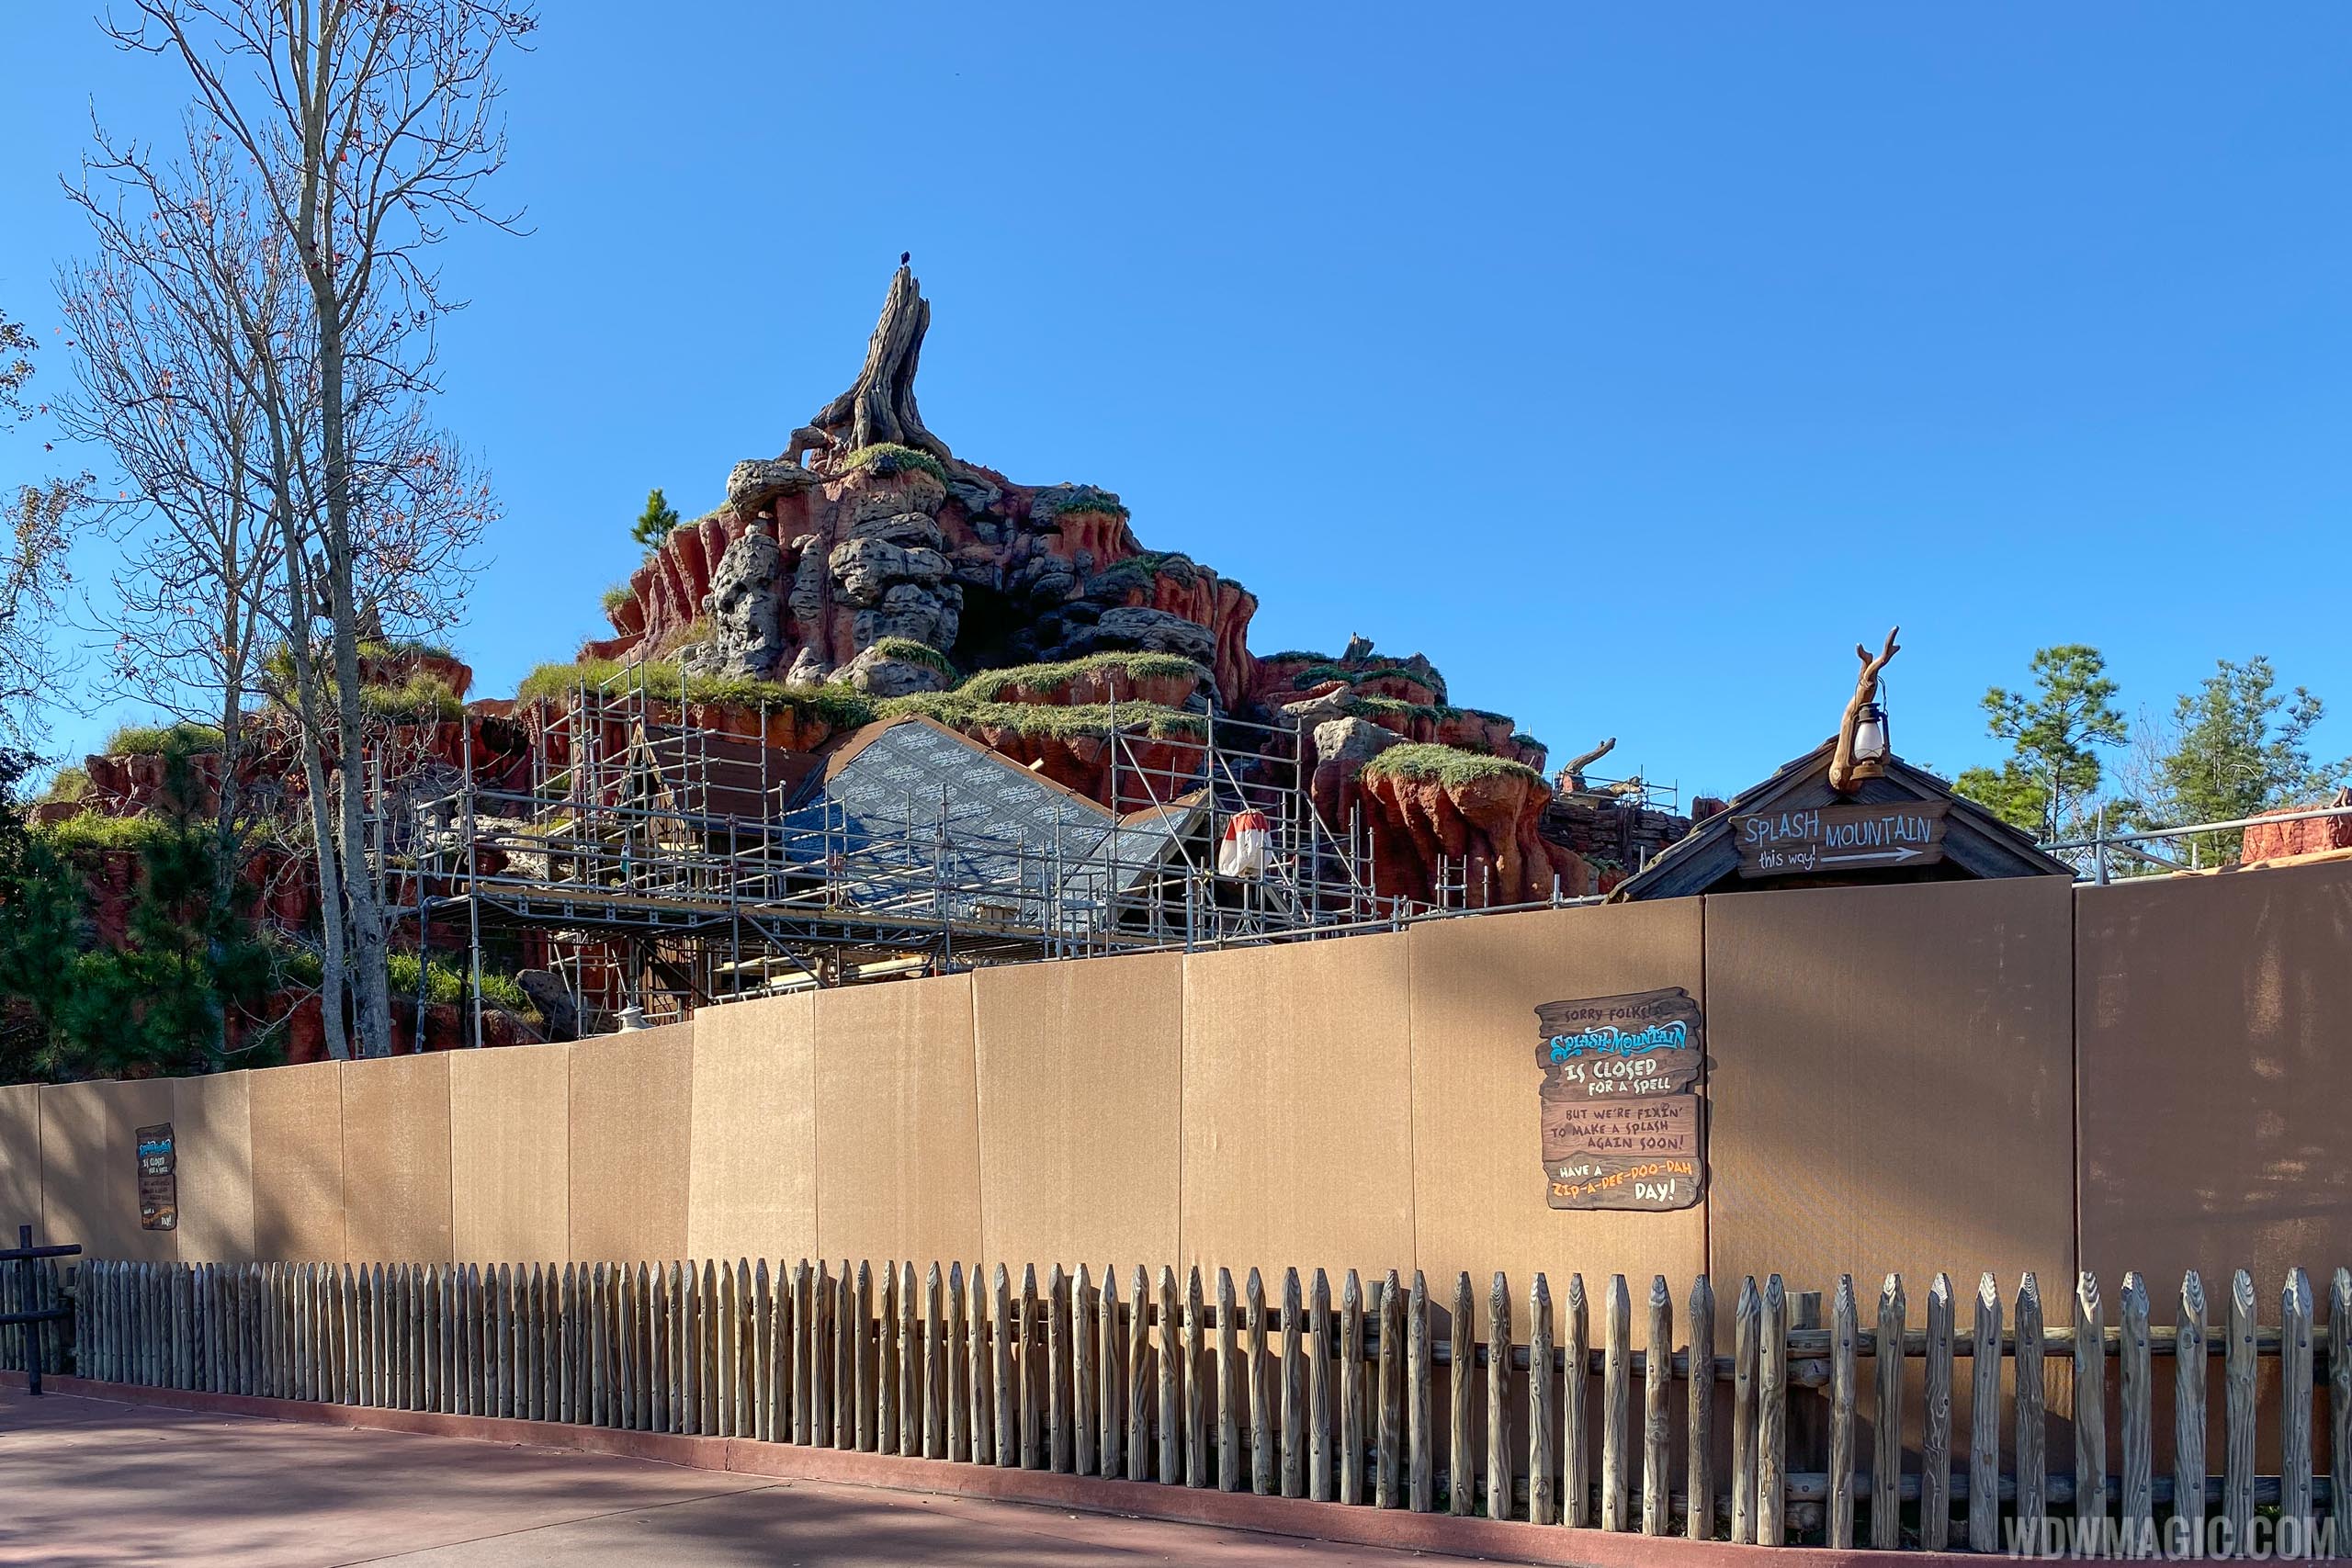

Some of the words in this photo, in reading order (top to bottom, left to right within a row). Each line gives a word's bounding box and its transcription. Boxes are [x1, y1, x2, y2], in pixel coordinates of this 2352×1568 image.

[997, 784, 1029, 798] GRACE
[983, 819, 1015, 833] GRACE
[1745, 809, 1820, 848] SPLASH
[1825, 814, 1931, 849] MOUNTAIN
[1758, 849, 1783, 870] this
[1788, 844, 1816, 871] way!
[1565, 1009, 1602, 1022] SORRY
[1550, 1032, 1611, 1064] SPLASH
[1605, 1020, 1687, 1057] MOUNTAIN
[1565, 1063, 1586, 1082] IS
[1592, 1058, 1657, 1080] CLOSED
[1588, 1080, 1613, 1096] FOR
[1619, 1082, 1628, 1092] A
[1633, 1077, 1671, 1094] SPELL
[1566, 1108, 1588, 1121] BUT
[1593, 1108, 1632, 1120] WE'RE
[1637, 1106, 1683, 1120] FIXIN'
[1551, 1127, 1566, 1138] TO
[1572, 1123, 1606, 1136] MAKE
[1611, 1124, 1620, 1134] A
[1625, 1121, 1668, 1135] SPLASH
[1588, 1137, 1633, 1149] AGAIN
[1640, 1136, 1684, 1150] SOON!
[1552, 1159, 1692, 1200] ZIP-A-DEE-DOO-DAH
[1559, 1165, 1590, 1178] HAVE
[1593, 1165, 1603, 1177] A
[1634, 1178, 1676, 1202] DAY!
